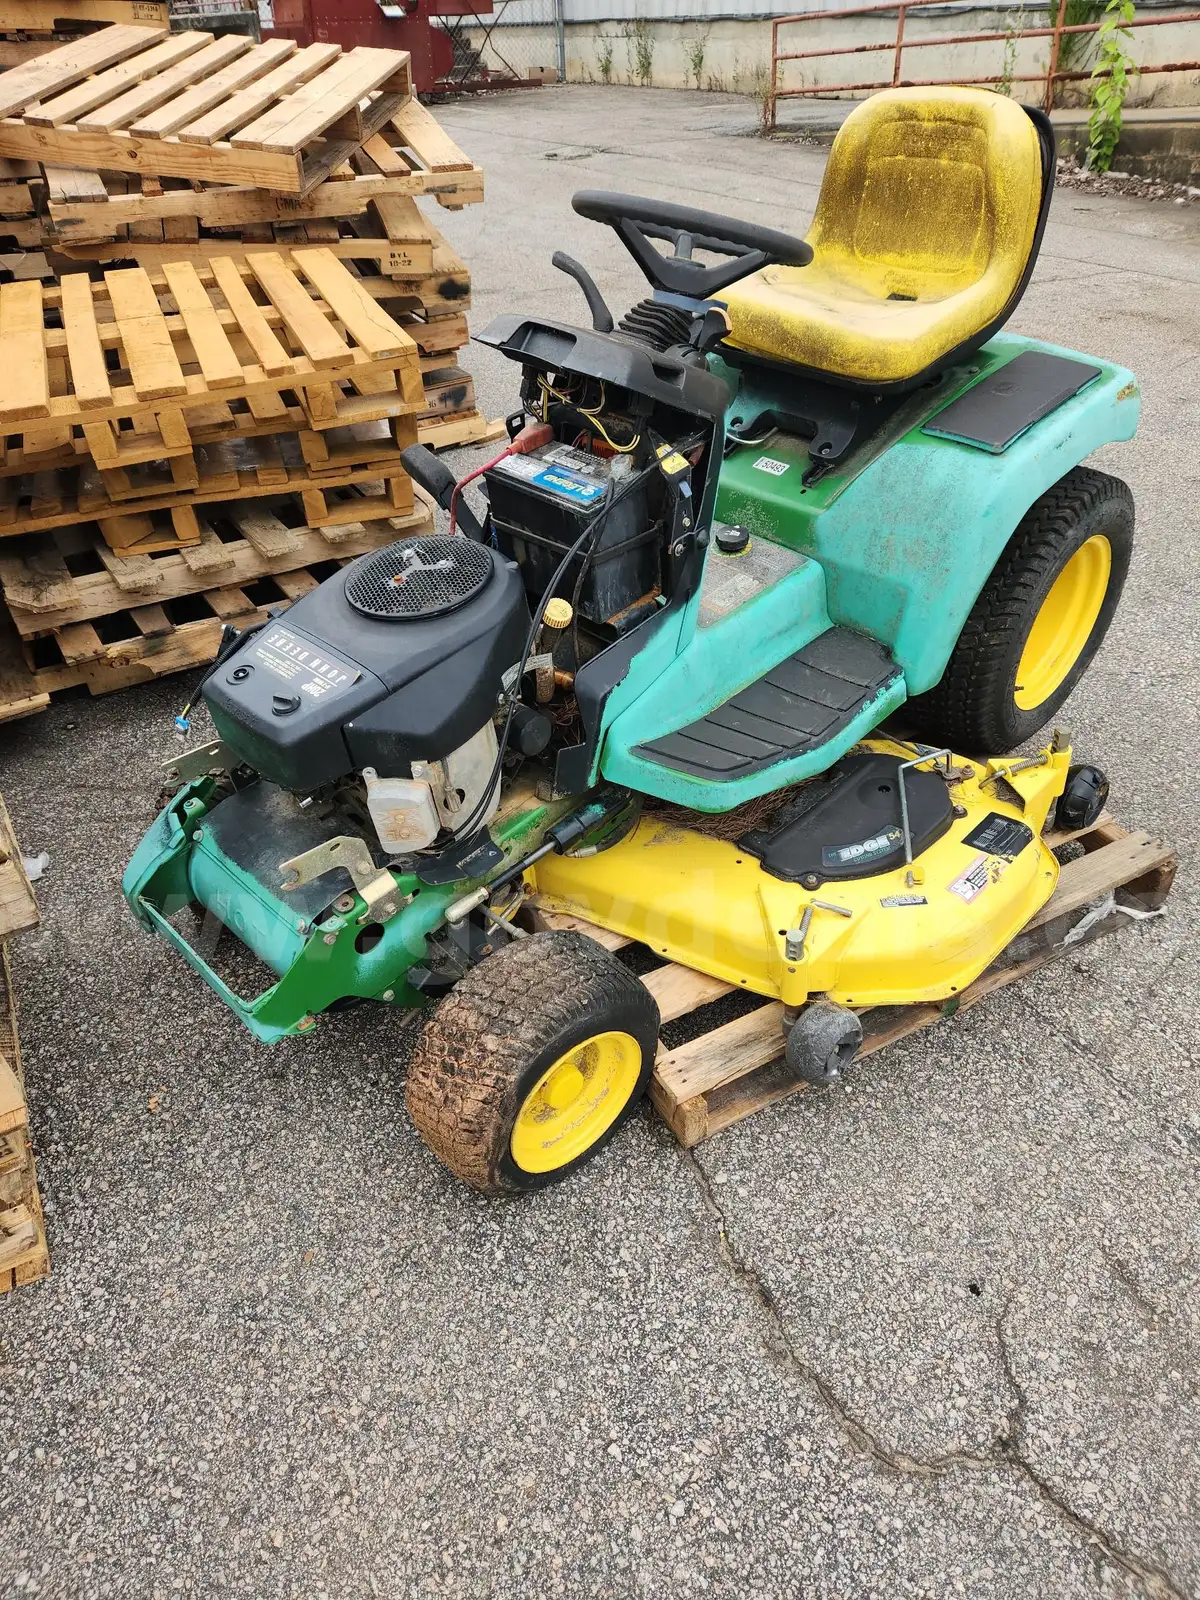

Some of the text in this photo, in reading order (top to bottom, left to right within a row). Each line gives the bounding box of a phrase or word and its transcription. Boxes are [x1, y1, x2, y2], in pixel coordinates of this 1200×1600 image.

[762, 460, 786, 473] 50493
[267, 634, 309, 661] DEERE
[310, 658, 348, 683] JOHN
[300, 682, 327, 697] 20HP
[838, 834, 891, 862] EDGE
